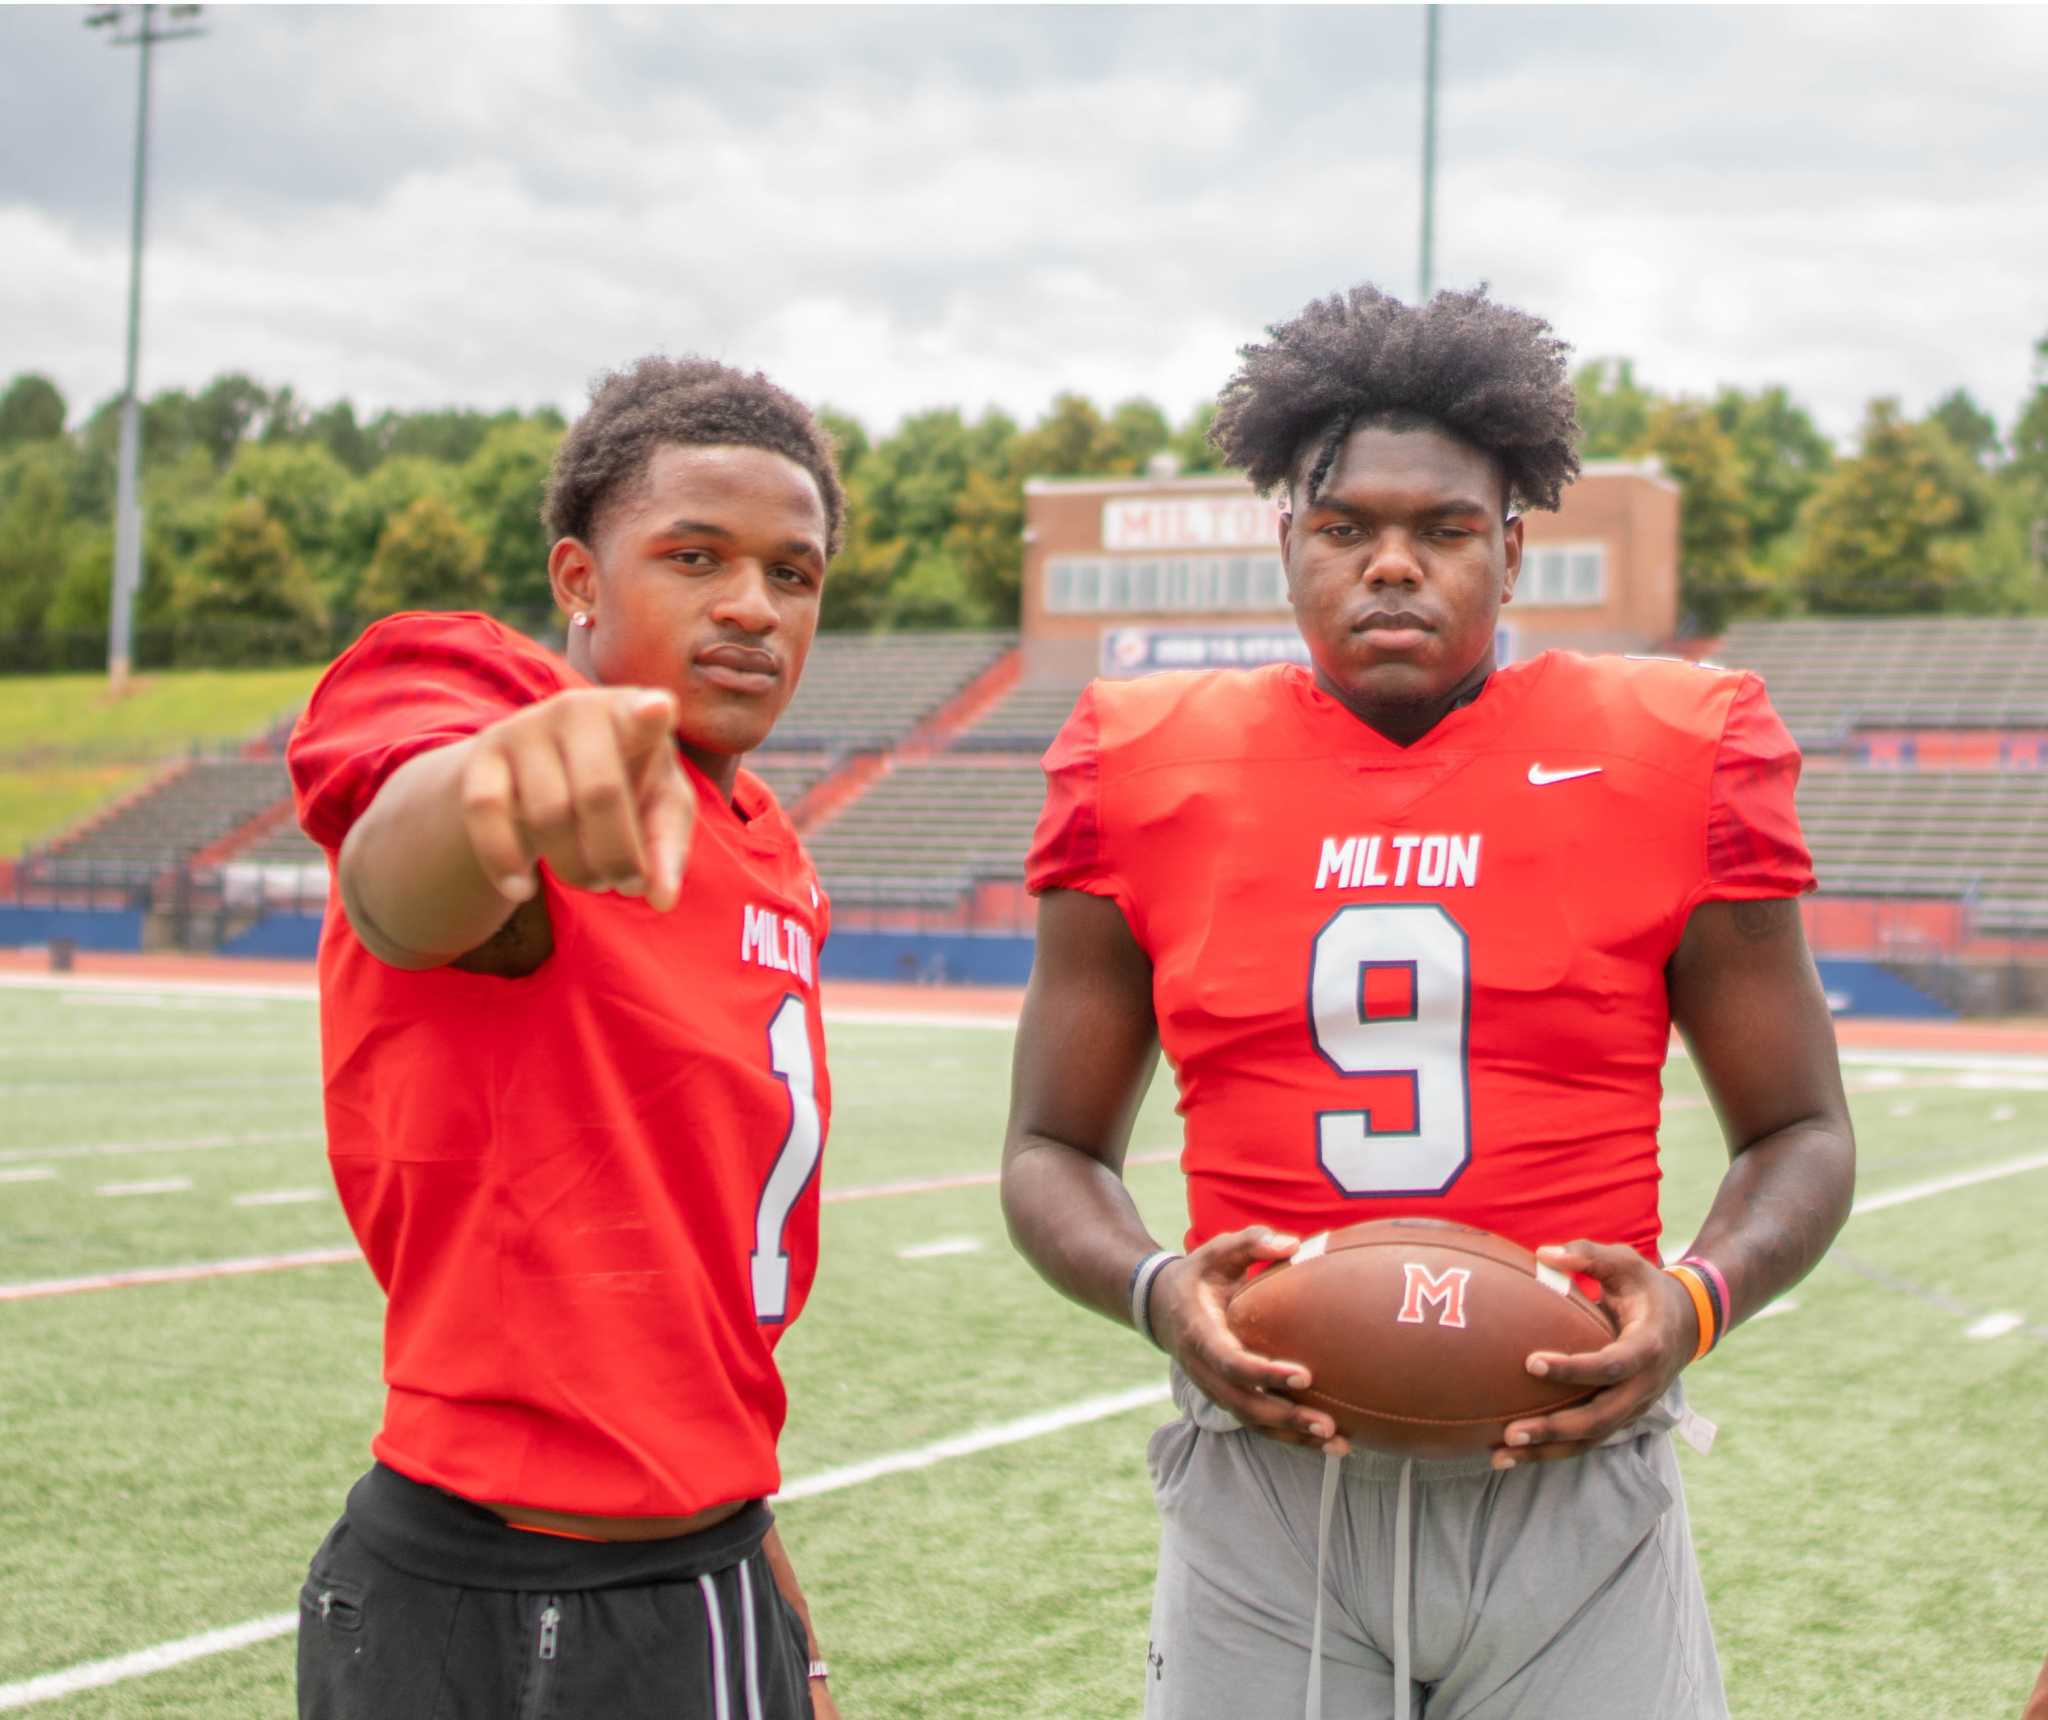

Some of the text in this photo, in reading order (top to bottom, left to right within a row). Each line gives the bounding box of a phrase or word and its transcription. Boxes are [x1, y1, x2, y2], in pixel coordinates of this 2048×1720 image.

[1315, 834, 1481, 889] MILTON
[1308, 903, 1472, 1196] 9
[749, 992, 821, 1324] 1
[1397, 1263, 1471, 1328] M
